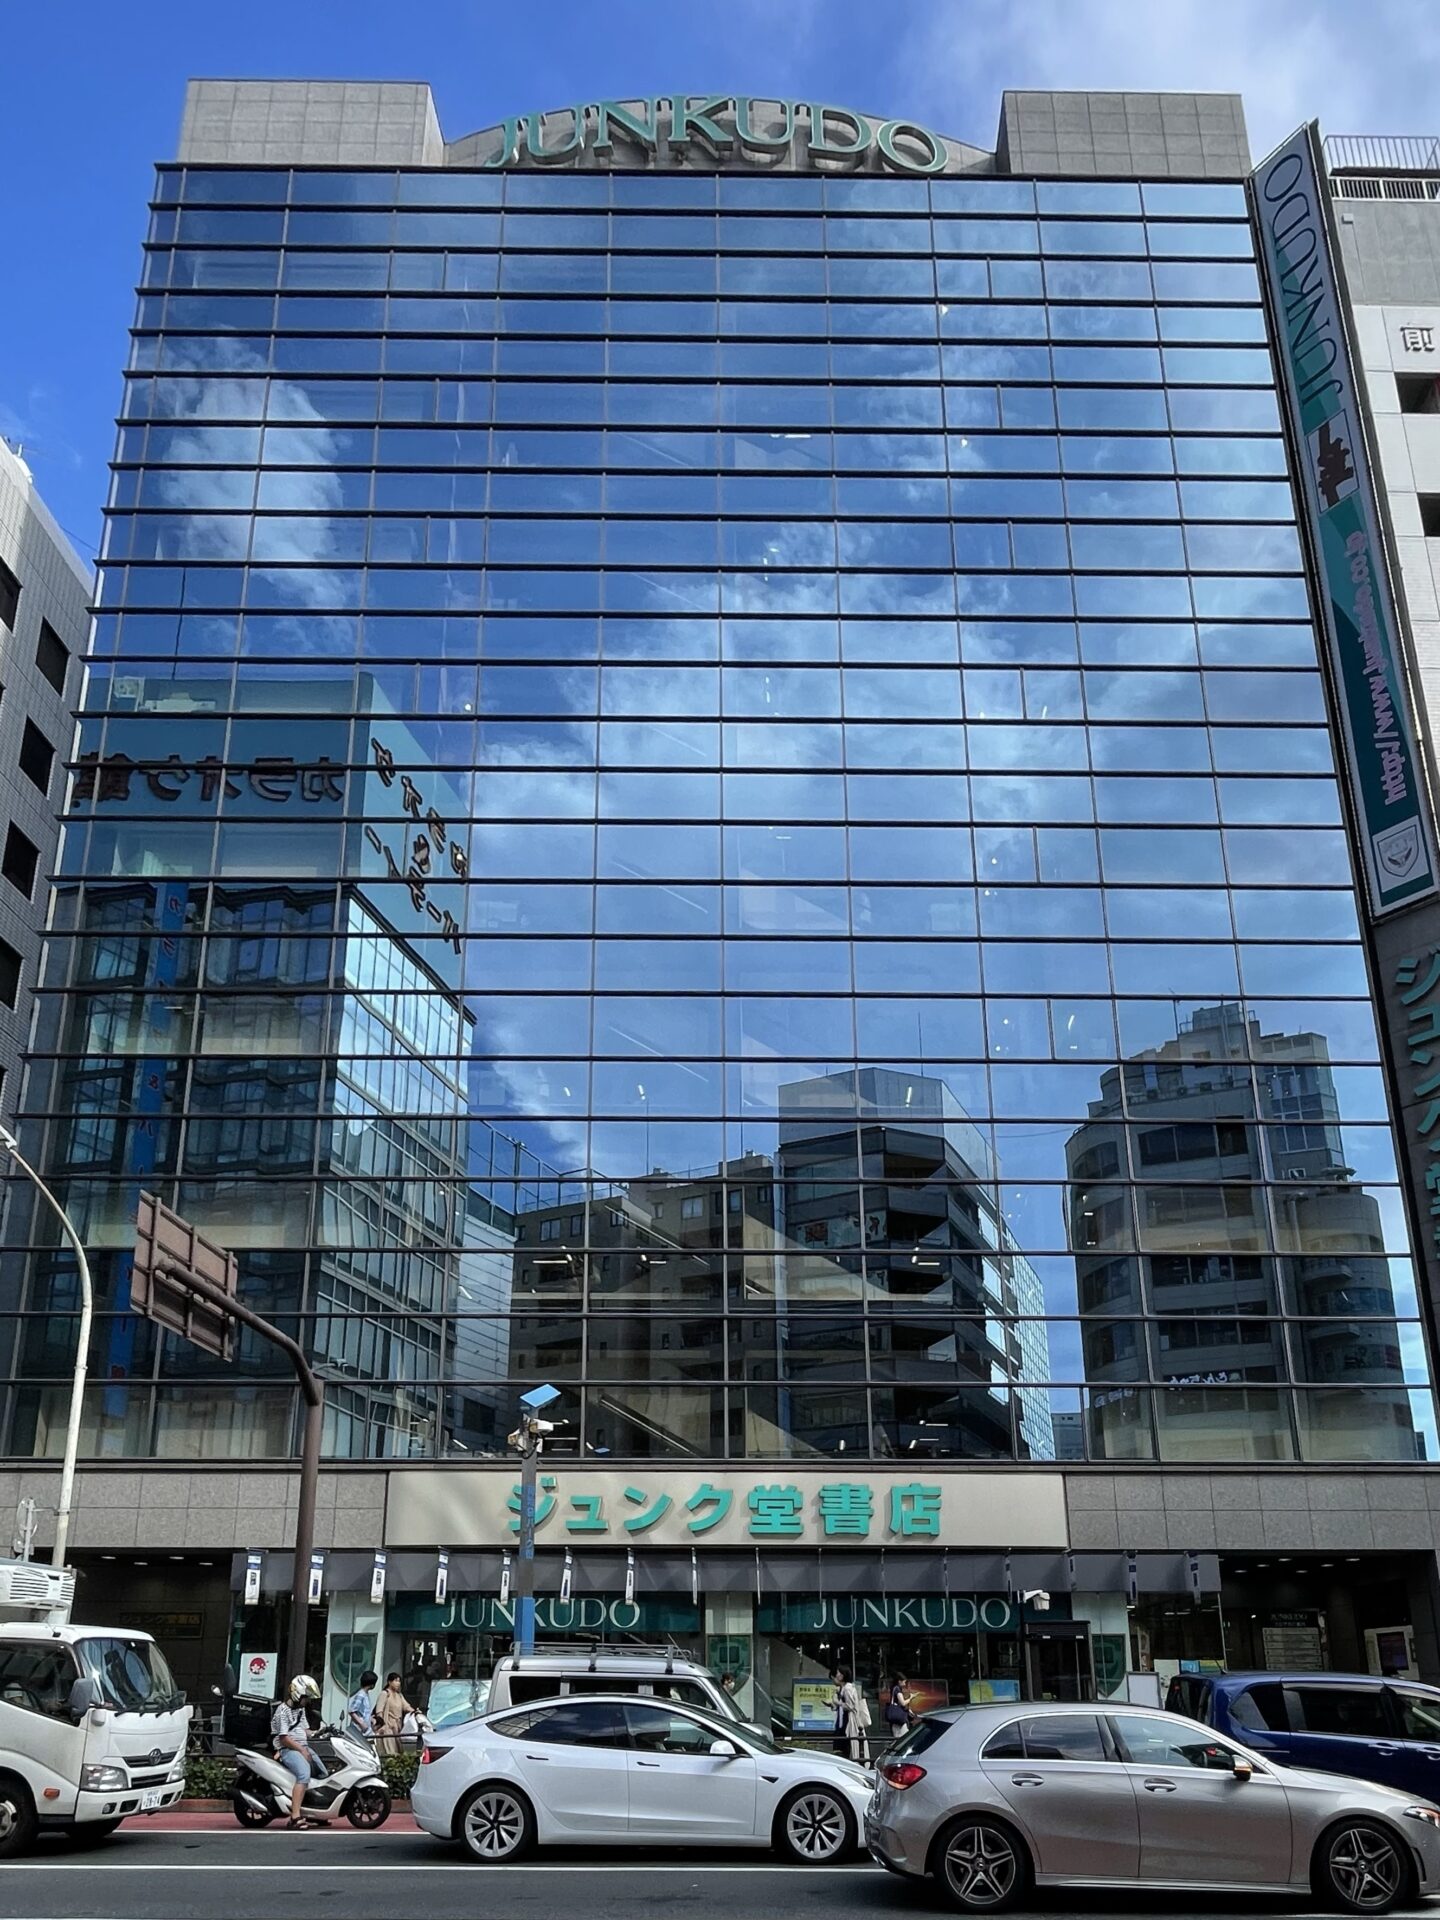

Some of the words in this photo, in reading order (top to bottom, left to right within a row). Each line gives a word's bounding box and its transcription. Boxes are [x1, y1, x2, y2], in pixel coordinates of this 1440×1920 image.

[484, 94, 949, 173] JUNKUDO
[1263, 151, 1344, 410] JUNKUDO
[506, 1475, 942, 1536] ジュンク堂書店
[441, 1596, 641, 1629] JUNKUDO
[813, 1597, 1012, 1629] JUNKUDO
